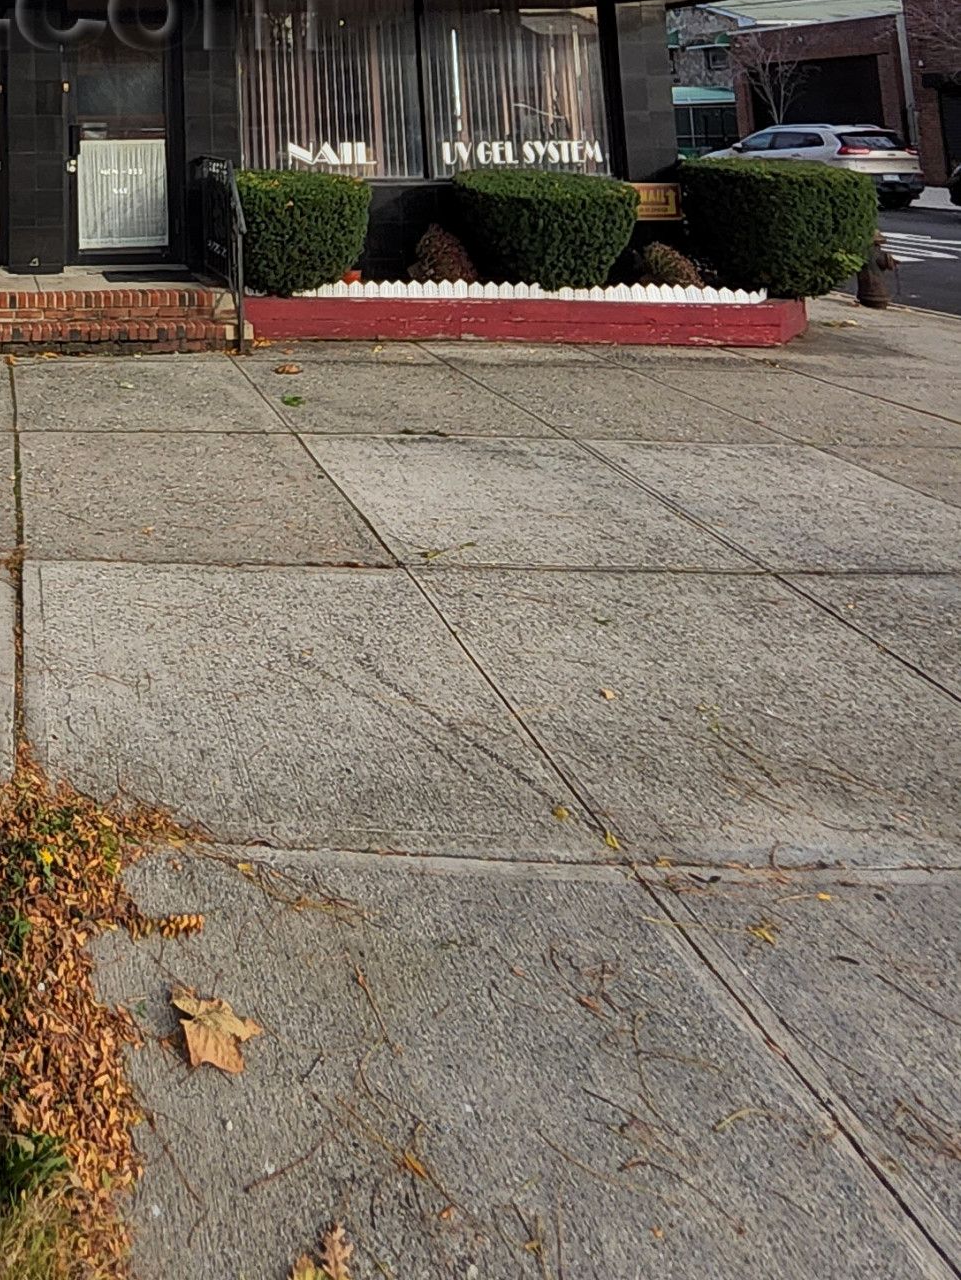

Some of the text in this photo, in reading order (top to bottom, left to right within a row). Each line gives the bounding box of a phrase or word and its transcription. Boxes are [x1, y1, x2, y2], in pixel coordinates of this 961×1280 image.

[288, 140, 378, 166] NAIL
[442, 139, 604, 166] UV GEL SYSTEM
